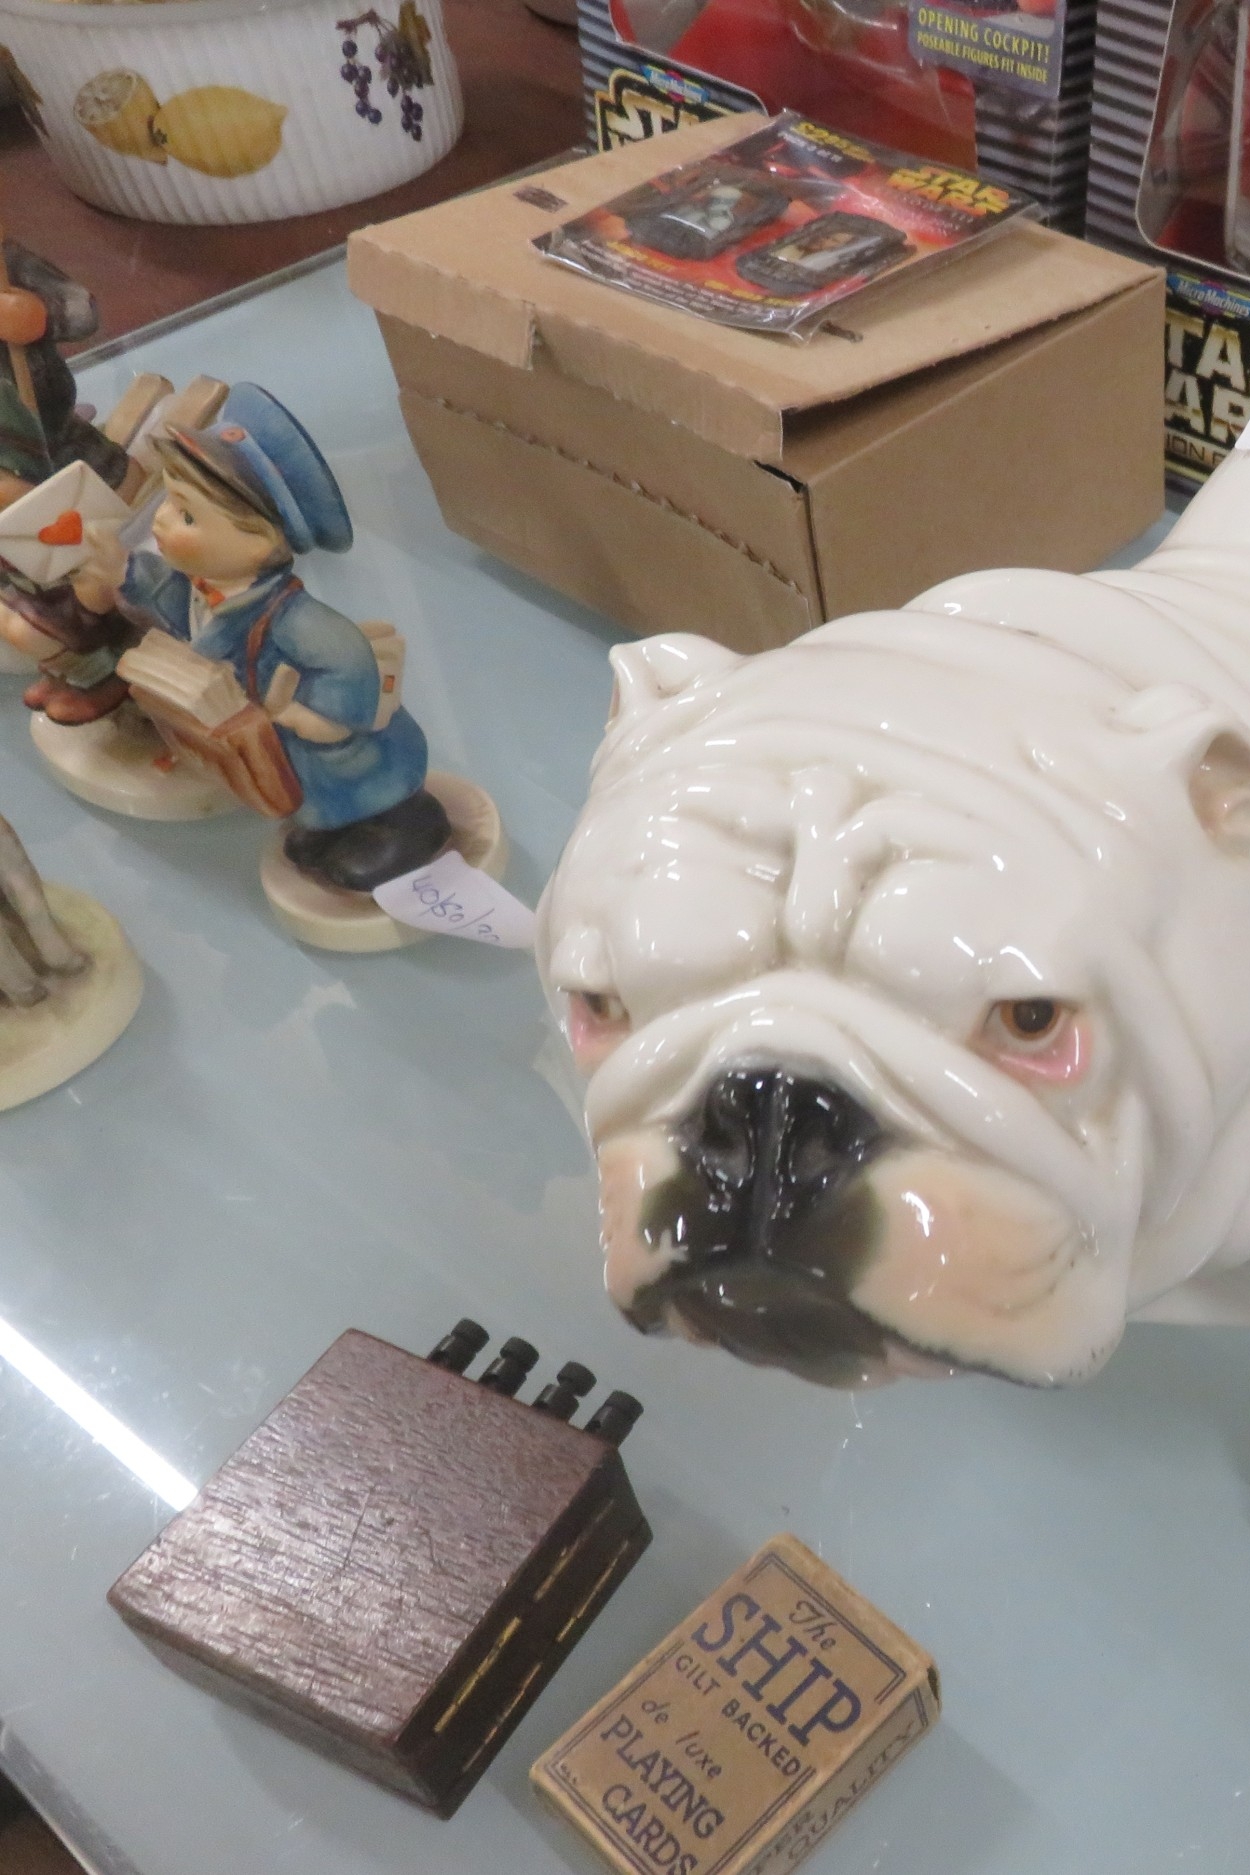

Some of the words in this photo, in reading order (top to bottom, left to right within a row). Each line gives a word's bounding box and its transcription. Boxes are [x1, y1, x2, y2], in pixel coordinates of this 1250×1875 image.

[917, 31, 960, 57] POSEABLE
[962, 44, 999, 69] FIGURES
[1001, 57, 1015, 74] FIT
[1017, 62, 1048, 84] INSIDE
[918, 7, 979, 42] OPENING
[983, 27, 1049, 64] COCKPIT!
[691, 1593, 862, 1747] SHIP
[789, 1600, 837, 1651] The
[641, 1699, 671, 1725] de
[675, 1730, 722, 1779] luxe
[675, 1654, 721, 1696] GILT
[721, 1698, 801, 1776] BACKED
[600, 1713, 726, 1840] PLAYING
[787, 1720, 916, 1861] QUALITY
[602, 1784, 699, 1875] CARDS
